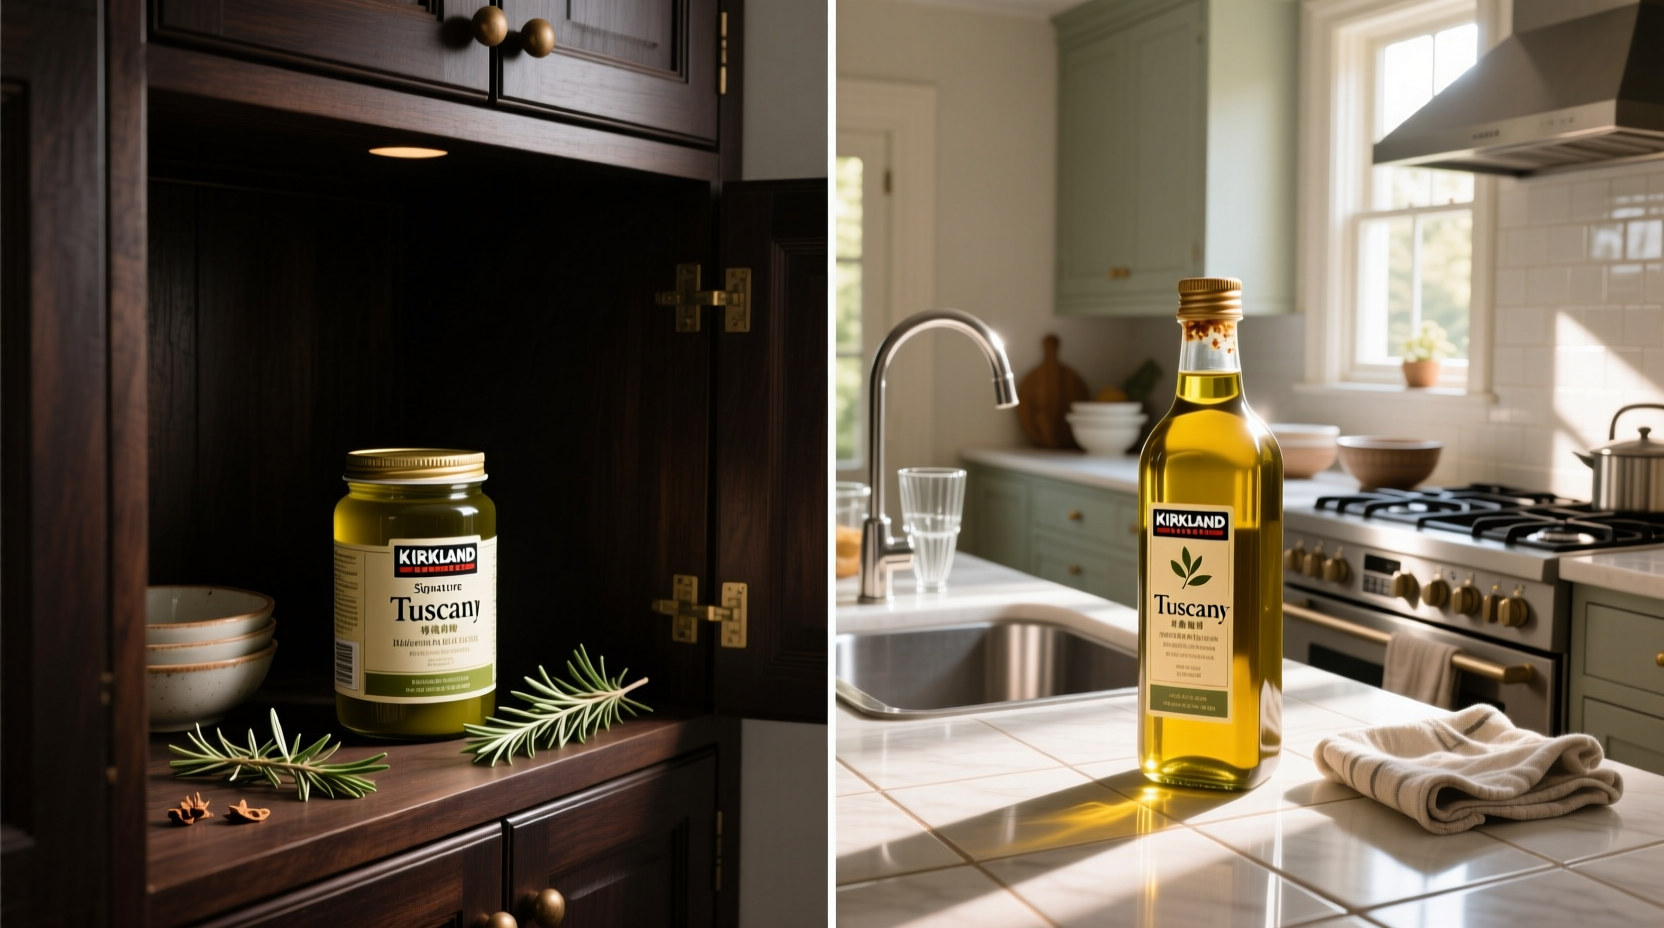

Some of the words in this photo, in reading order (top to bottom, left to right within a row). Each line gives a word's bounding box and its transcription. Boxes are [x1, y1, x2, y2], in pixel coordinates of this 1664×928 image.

[1156, 511, 1226, 529] KIRKLAND
[399, 547, 476, 565] KIRKLAND
[390, 596, 481, 623] Tuscany
[1154, 594, 1230, 625] Tuscany
